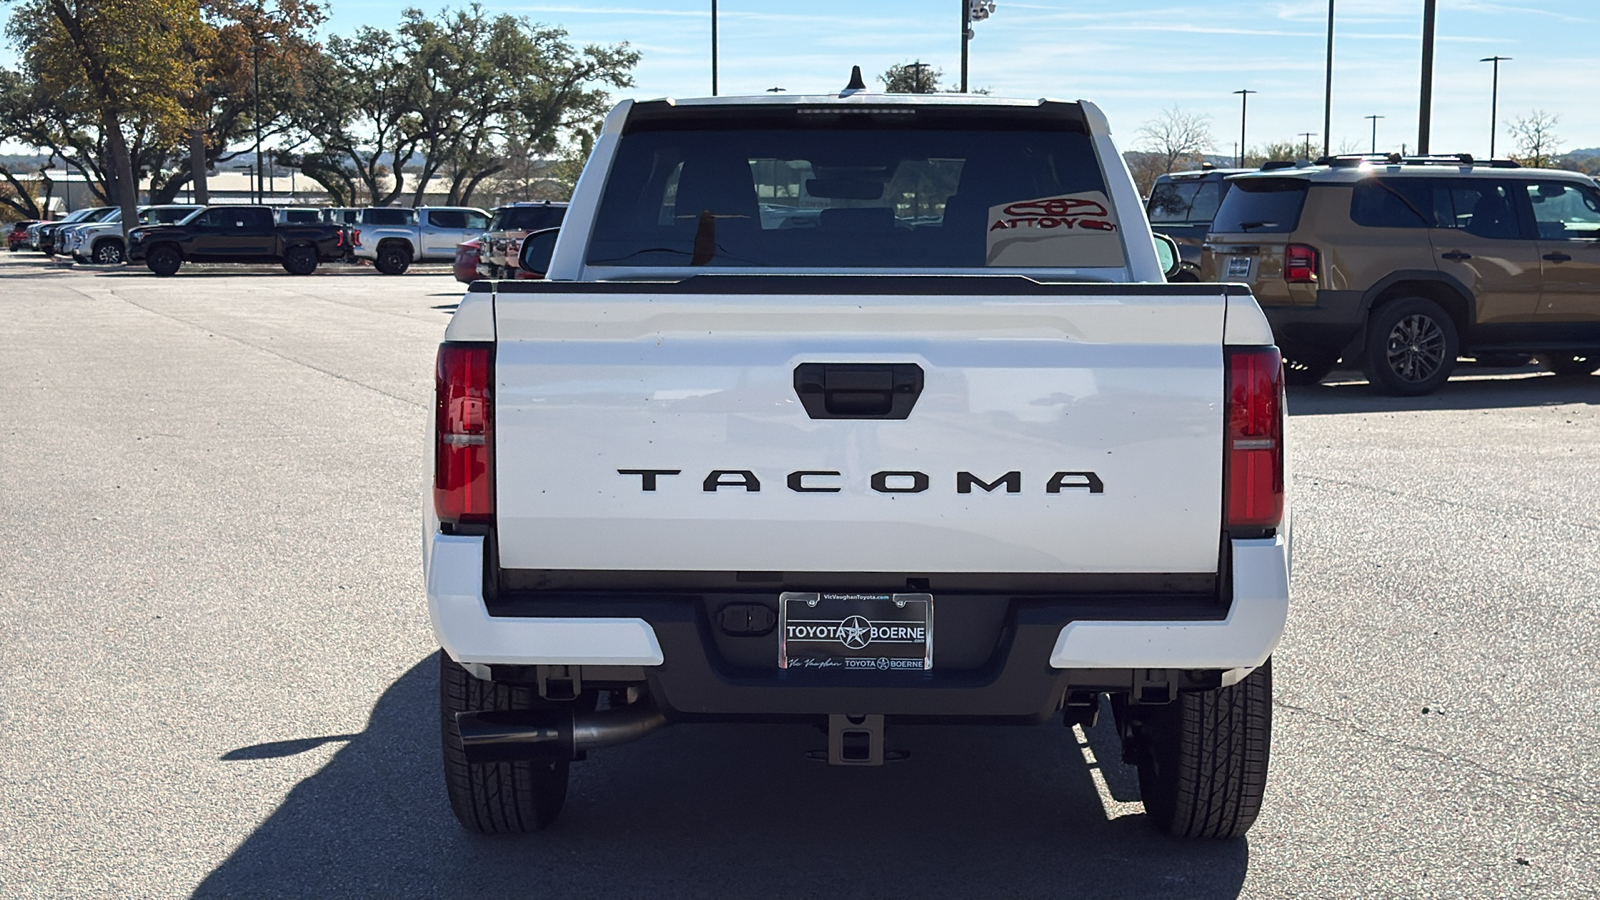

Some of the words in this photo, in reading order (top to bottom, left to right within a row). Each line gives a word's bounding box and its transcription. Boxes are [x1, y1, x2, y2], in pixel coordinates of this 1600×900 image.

[616, 468, 1105, 494] TACOMA
[787, 626, 847, 638] TOYOTA
[870, 626, 925, 639] BOERNE
[891, 660, 923, 668] BOERNE
